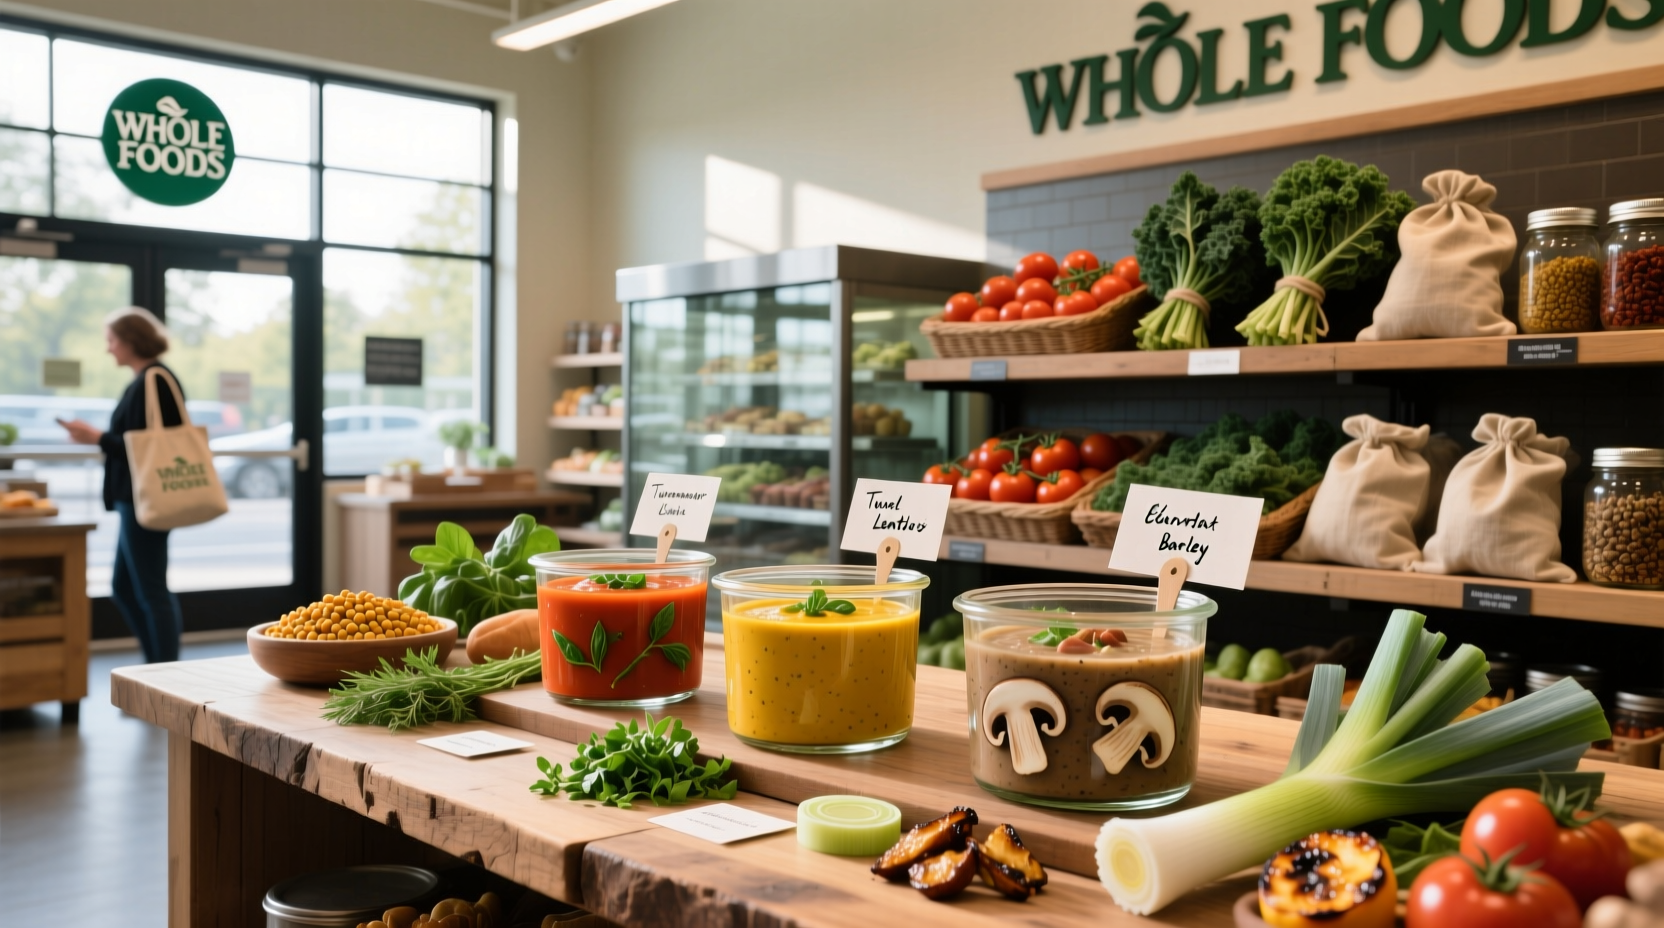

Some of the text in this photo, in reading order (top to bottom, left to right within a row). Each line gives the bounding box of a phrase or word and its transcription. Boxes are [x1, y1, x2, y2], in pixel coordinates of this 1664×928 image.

[1014, 13, 1295, 135] WHOLE
[111, 108, 226, 151] WHOLE
[116, 139, 227, 180] FOODS
[1158, 532, 1209, 566] Barley
